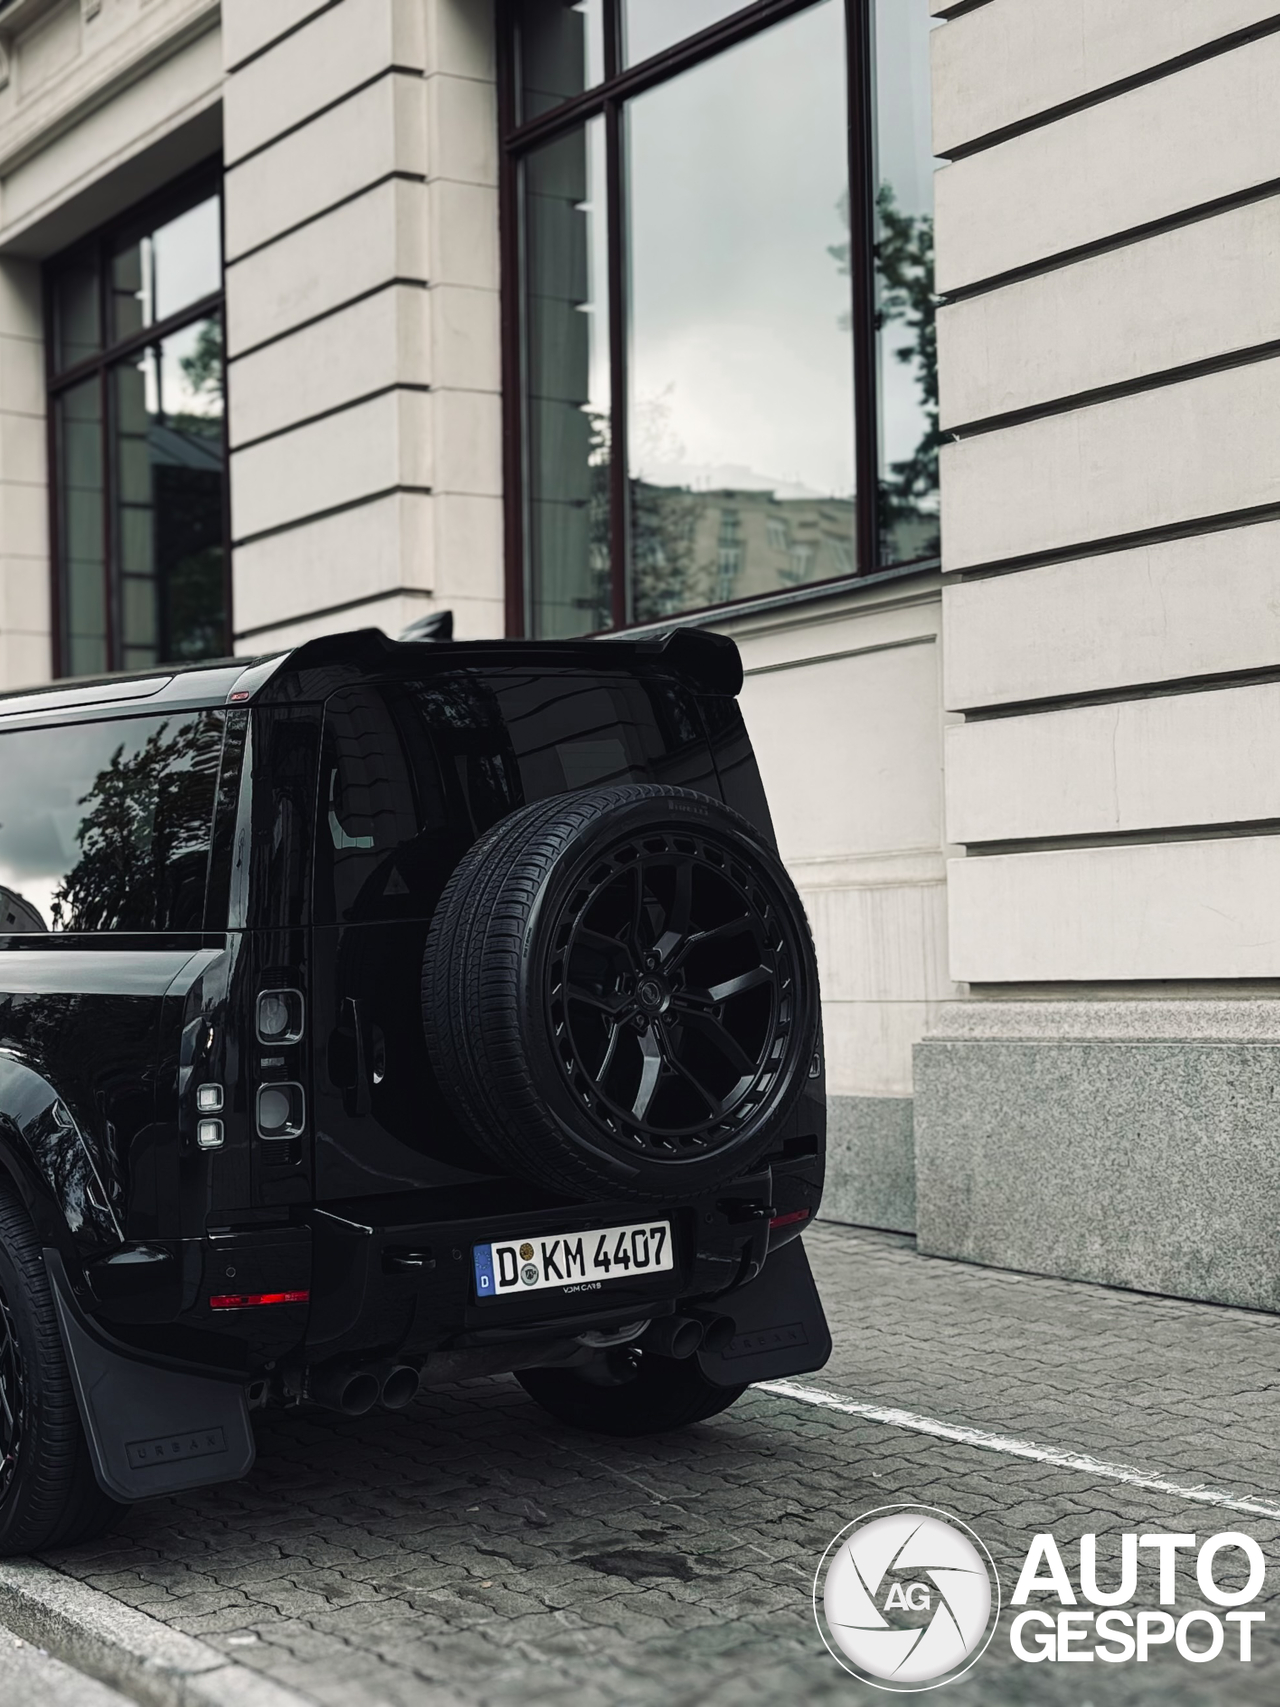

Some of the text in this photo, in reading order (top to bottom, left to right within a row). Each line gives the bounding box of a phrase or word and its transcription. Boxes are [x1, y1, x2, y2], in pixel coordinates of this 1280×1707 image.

[540, 1237, 586, 1281] KM
[593, 1226, 667, 1273] 4407
[480, 1275, 489, 1288] D
[136, 1434, 217, 1460] URBAN
